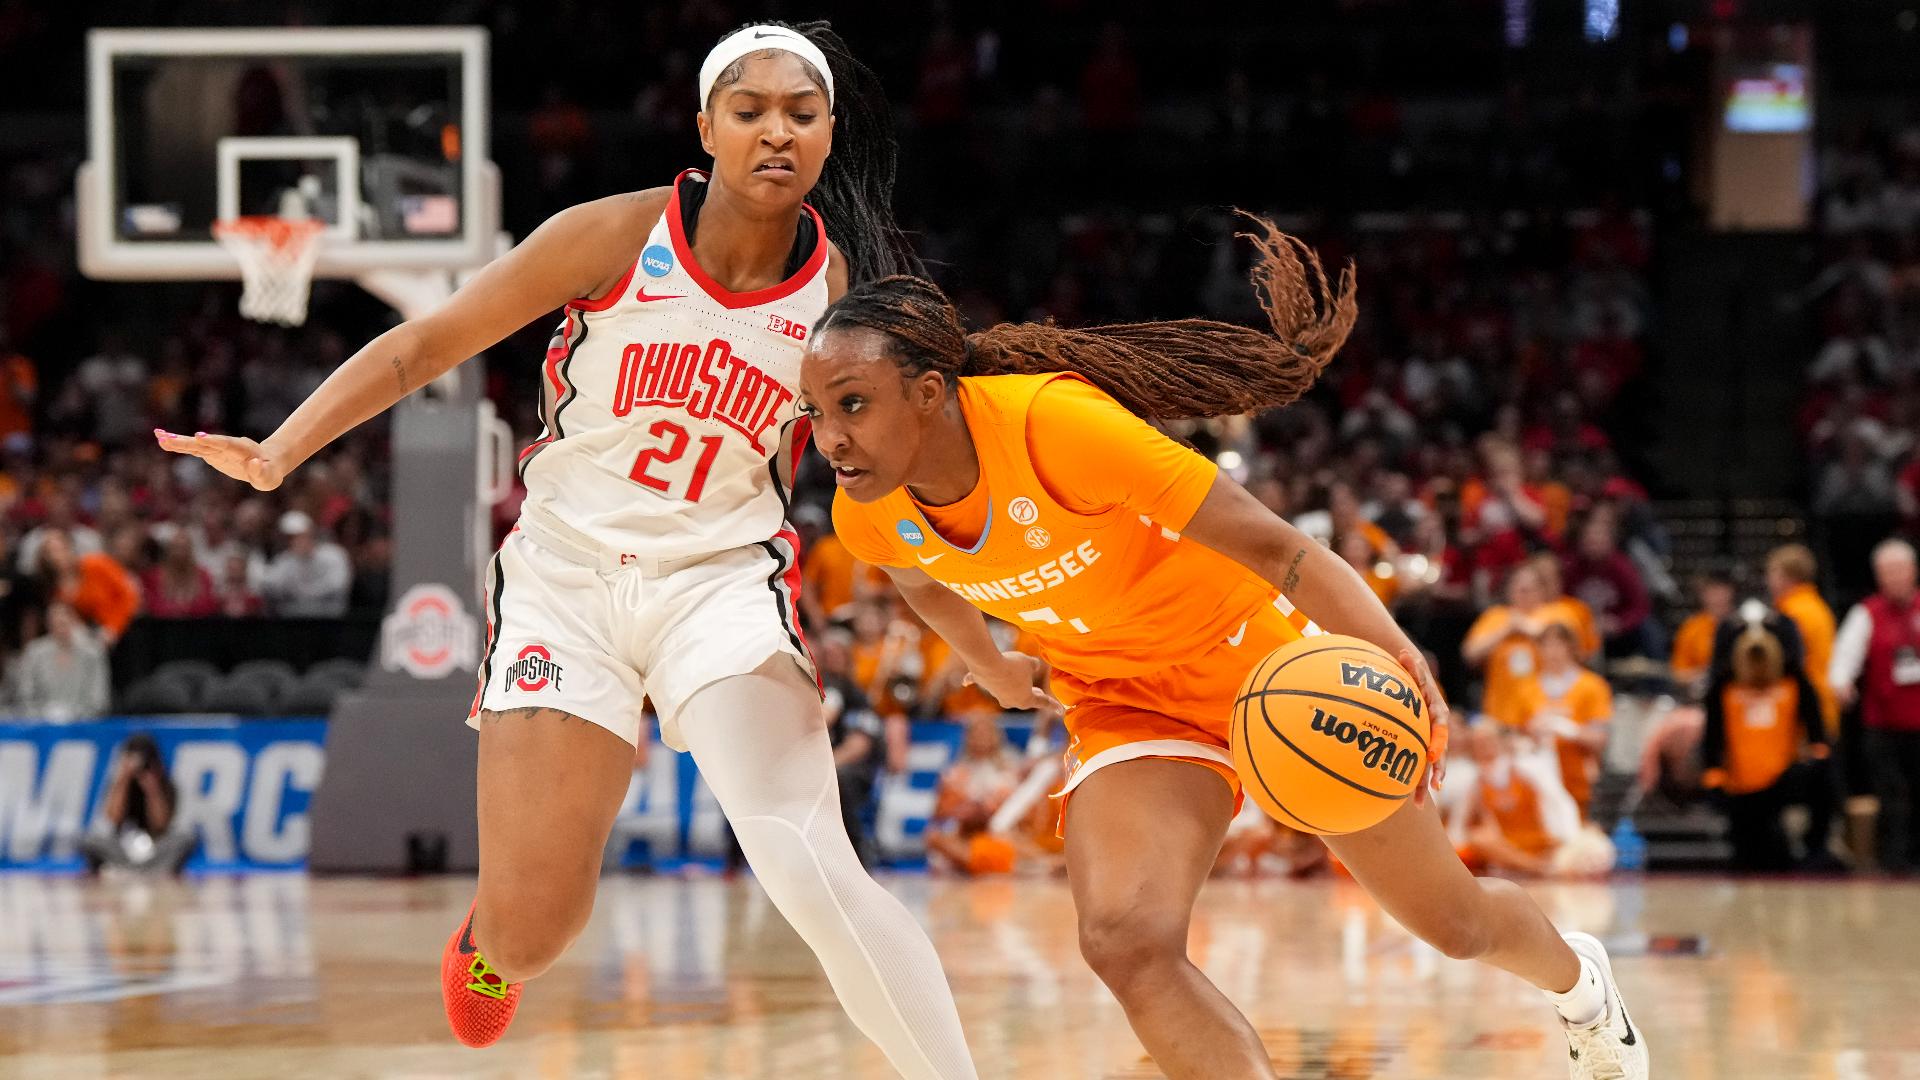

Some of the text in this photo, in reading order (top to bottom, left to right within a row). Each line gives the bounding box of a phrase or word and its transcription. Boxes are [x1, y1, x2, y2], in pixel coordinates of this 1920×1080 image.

[644, 256, 671, 272] NCAA
[628, 419, 724, 504] 21
[901, 531, 923, 541] NCAA
[1026, 526, 1049, 548] SEC
[1340, 662, 1422, 719] NCAA
[1361, 720, 1399, 741] EVO NXT
[1310, 707, 1419, 786] Wilson
